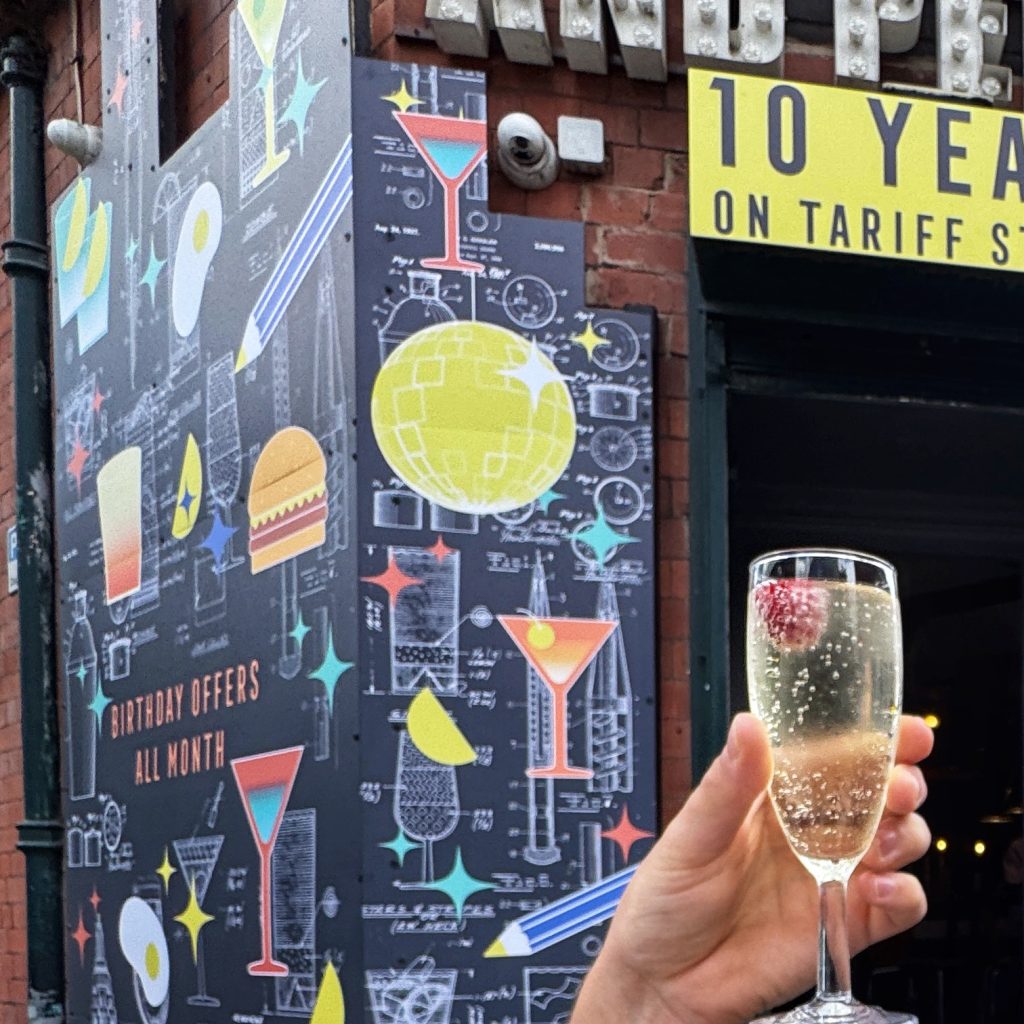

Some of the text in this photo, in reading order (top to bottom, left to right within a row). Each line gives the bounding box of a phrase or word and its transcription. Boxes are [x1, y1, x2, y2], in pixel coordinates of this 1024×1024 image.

[709, 76, 807, 176] 10
[714, 189, 769, 239] ON
[799, 199, 963, 260] TARIFF
[111, 658, 260, 739] BIRTHDAY OFFERS
[135, 729, 225, 785] ALL MONTH
